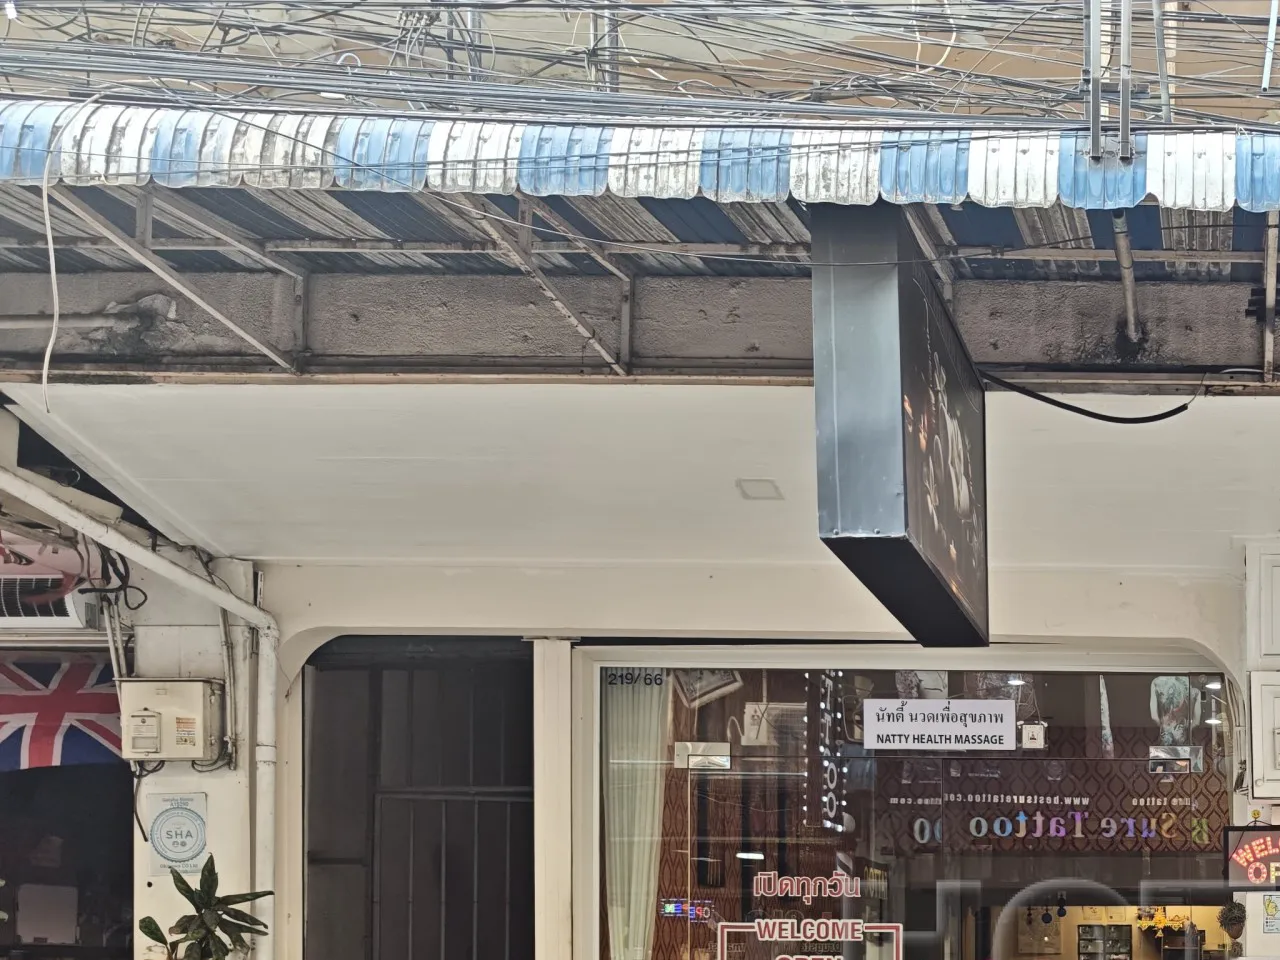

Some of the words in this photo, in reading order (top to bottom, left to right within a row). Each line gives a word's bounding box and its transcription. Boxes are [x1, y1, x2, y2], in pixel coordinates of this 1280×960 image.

[608, 672, 663, 686] 219/66
[876, 700, 908, 723] นัทดี้
[908, 700, 1004, 728] นวดเพื่อสุขภาพ
[876, 733, 910, 745] NATTY
[912, 733, 952, 745] HEALTH
[954, 734, 1004, 745] MASSAGE
[165, 830, 194, 839] SHA
[753, 871, 861, 905] เปิดทุกวัน
[755, 918, 864, 942] WELCOME
